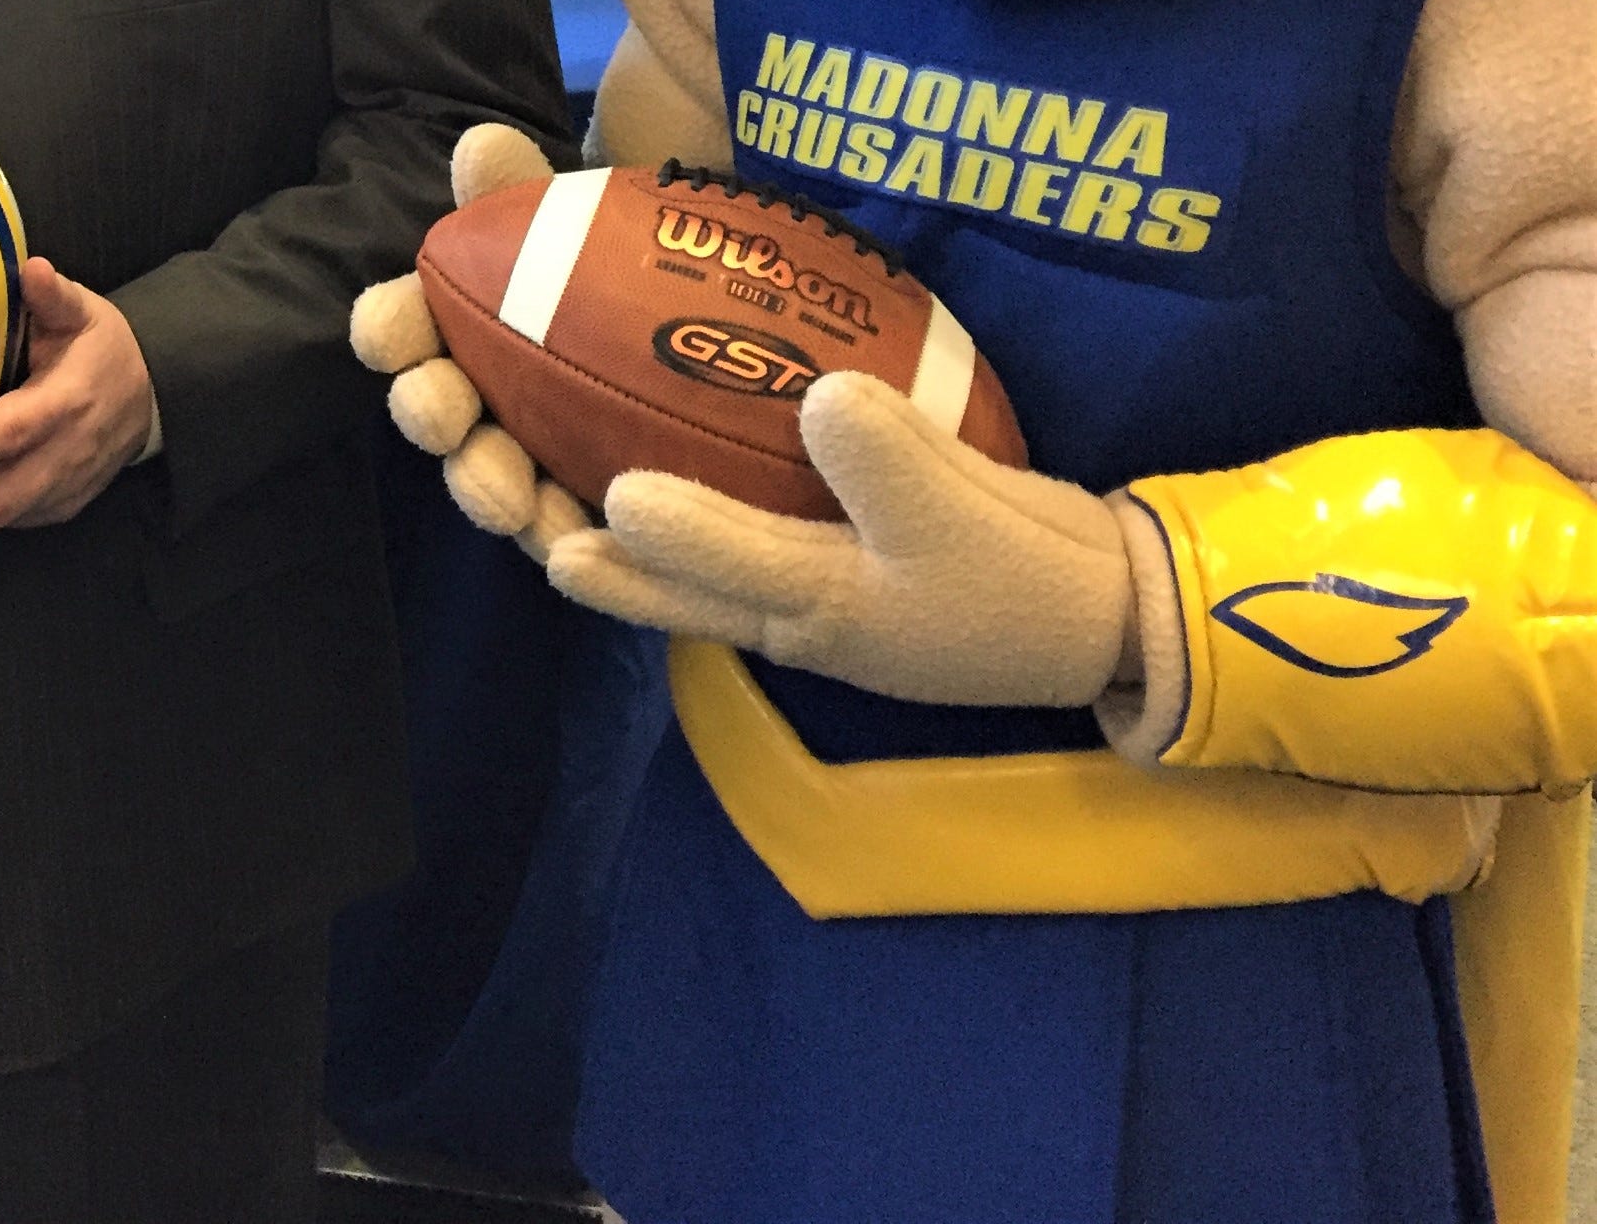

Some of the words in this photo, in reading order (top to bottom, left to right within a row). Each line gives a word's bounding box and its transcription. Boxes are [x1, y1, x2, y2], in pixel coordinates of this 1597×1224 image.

[736, 89, 1221, 254] CRUSADERS
[756, 32, 1169, 176] MADONNA
[656, 206, 879, 335] Wilson
[670, 325, 817, 393] GST
